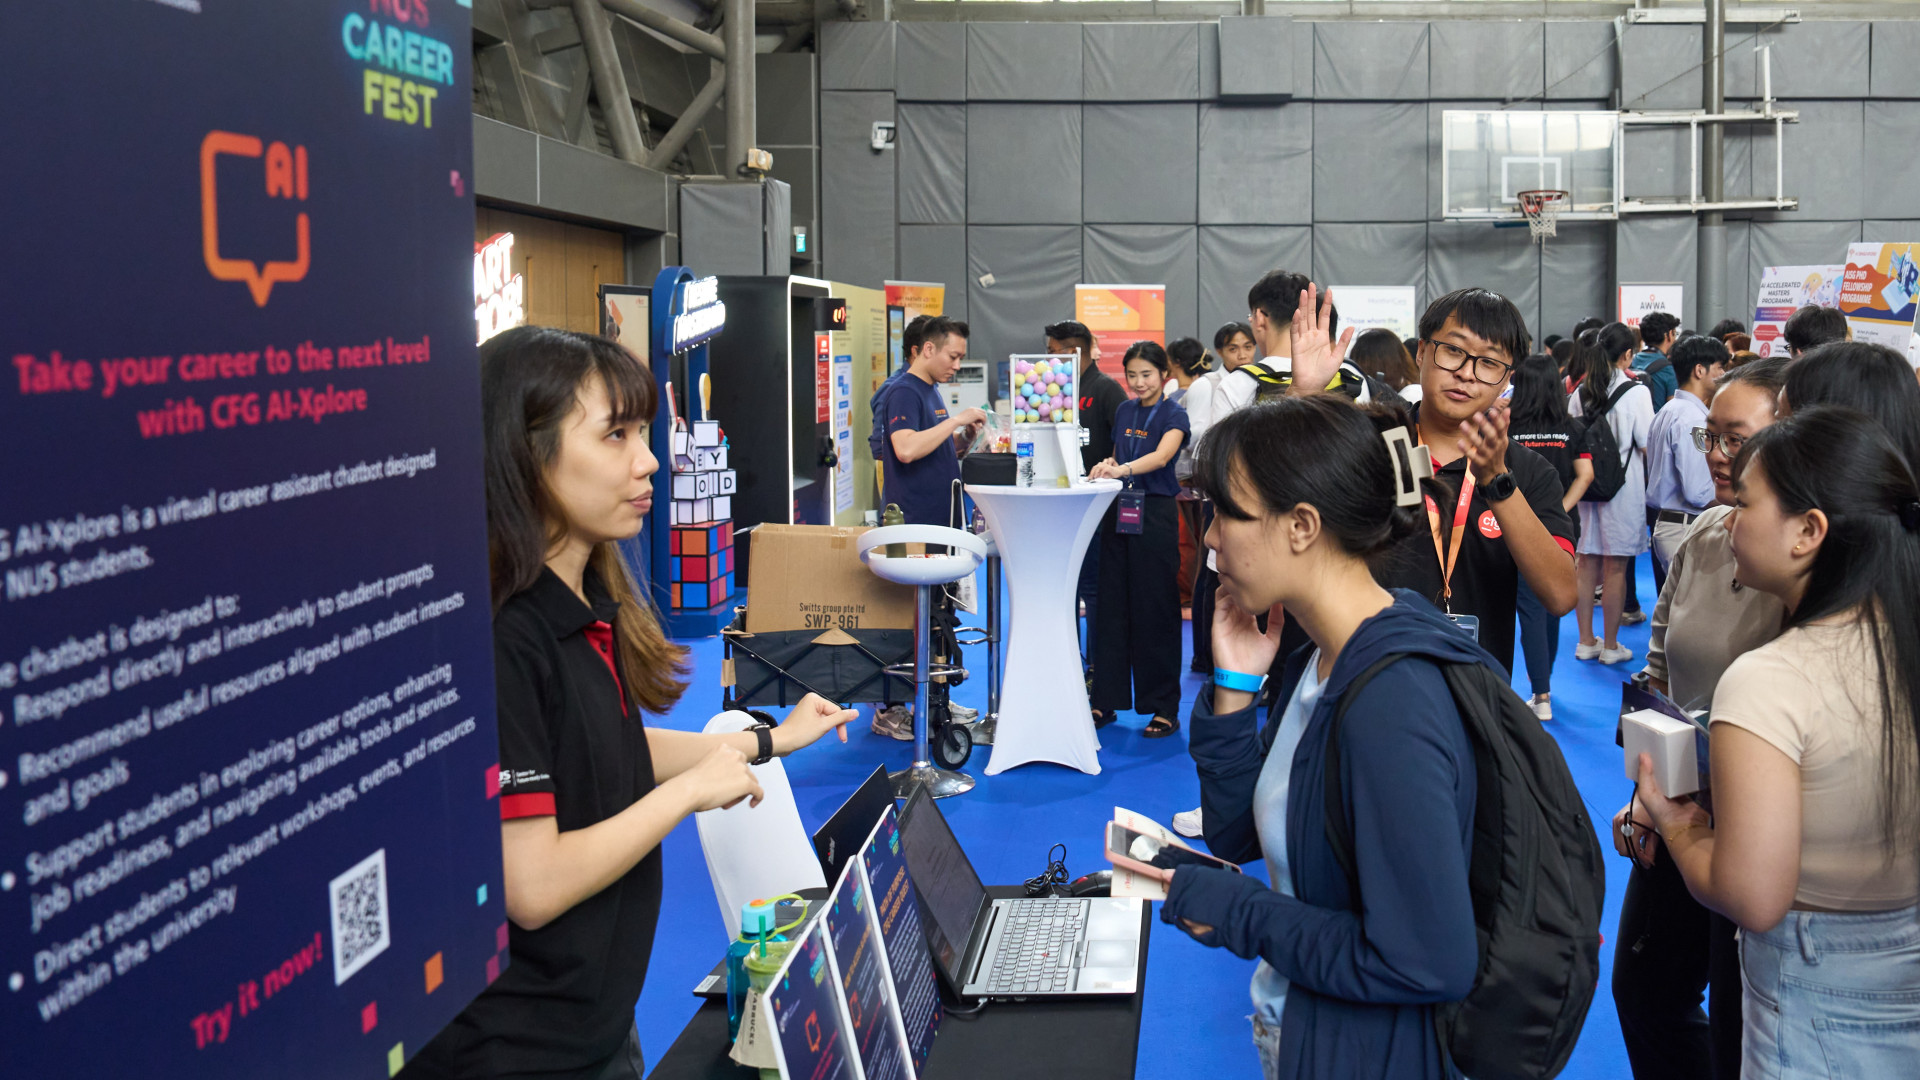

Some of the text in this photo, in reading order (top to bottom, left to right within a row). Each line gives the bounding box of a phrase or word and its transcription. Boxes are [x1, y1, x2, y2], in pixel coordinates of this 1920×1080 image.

[341, 11, 455, 86] CAREER
[364, 68, 438, 129] FEST
[265, 140, 308, 200] AI
[1640, 301, 1666, 310] AWWA
[1767, 281, 1801, 289] ACCELERATED
[1841, 293, 1872, 304] PROGRAMME
[1843, 281, 1873, 292] FELLOWSHIP
[1856, 271, 1867, 280] PHD
[1627, 317, 1640, 326] WE
[13, 335, 430, 398] Take your career to the next level
[138, 384, 367, 438] with CFG AI-Xplore
[711, 452, 721, 465] Y
[724, 477, 732, 490] D
[15, 513, 120, 556] AI-Xplore
[122, 505, 140, 533] is
[141, 506, 156, 529] a
[157, 487, 217, 525] virtual
[218, 484, 270, 513] career
[271, 469, 334, 502] assistant
[333, 460, 383, 488] chatbot
[384, 448, 436, 478] designed
[6, 546, 154, 599] NUS students.
[20, 629, 107, 682] chatbot
[110, 624, 128, 652] is
[129, 595, 213, 647] designed
[214, 595, 240, 619] to:
[805, 613, 859, 629] SWP-961
[823, 605, 841, 614] group
[856, 603, 865, 613] ltd
[14, 667, 110, 726] Respond
[112, 644, 186, 690] directly
[187, 629, 222, 665] and
[223, 599, 317, 650] interactively
[317, 597, 335, 618] to
[335, 578, 385, 612] student
[385, 563, 434, 599] prompts
[18, 591, 465, 785] Recommend useful resources aligned with student interests
[23, 756, 130, 826] and goals
[26, 663, 452, 886] Support students in exploring career options, enhancing
[31, 688, 460, 934] job readiness, and navigating available tools and services.
[34, 716, 476, 983] Direct students to relevant workshops, events, and resources
[38, 884, 238, 1021] within the university
[190, 931, 323, 1049] Try it now!
